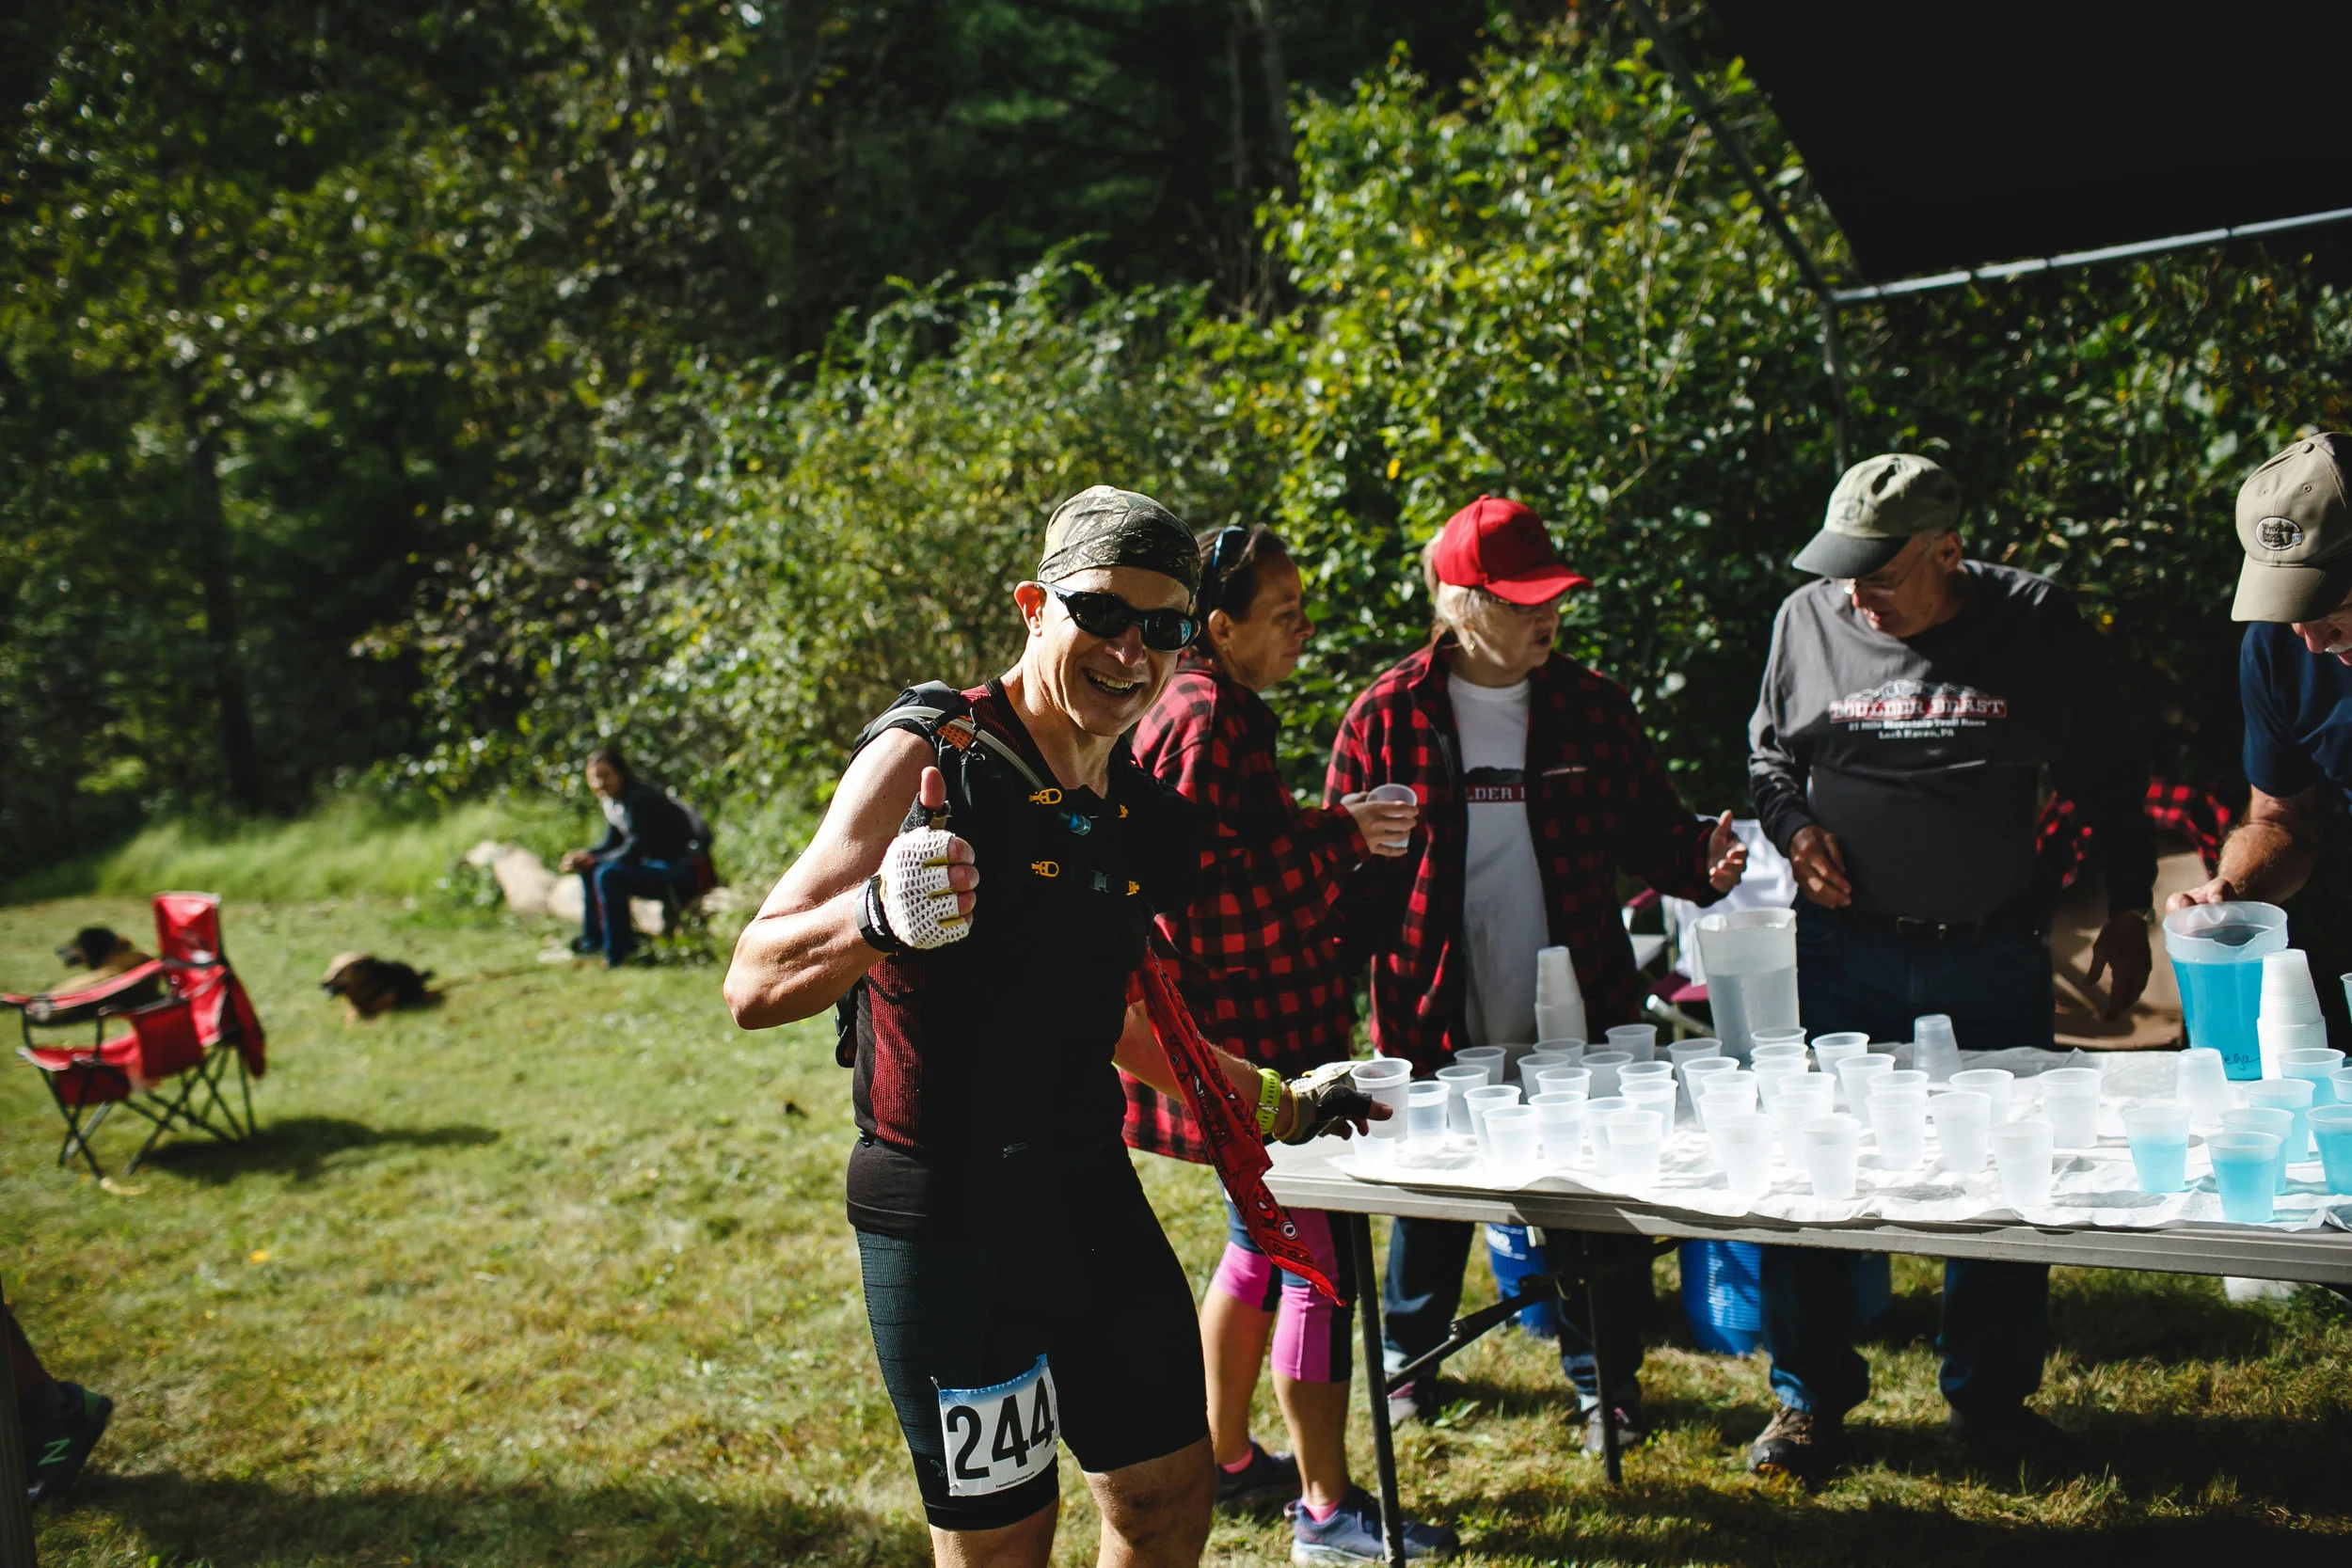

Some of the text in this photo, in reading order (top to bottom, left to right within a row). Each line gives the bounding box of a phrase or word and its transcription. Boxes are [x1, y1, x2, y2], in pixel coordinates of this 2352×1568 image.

[1830, 697, 2004, 719] BOULDER BEAST
[946, 1375, 1055, 1481] 244
